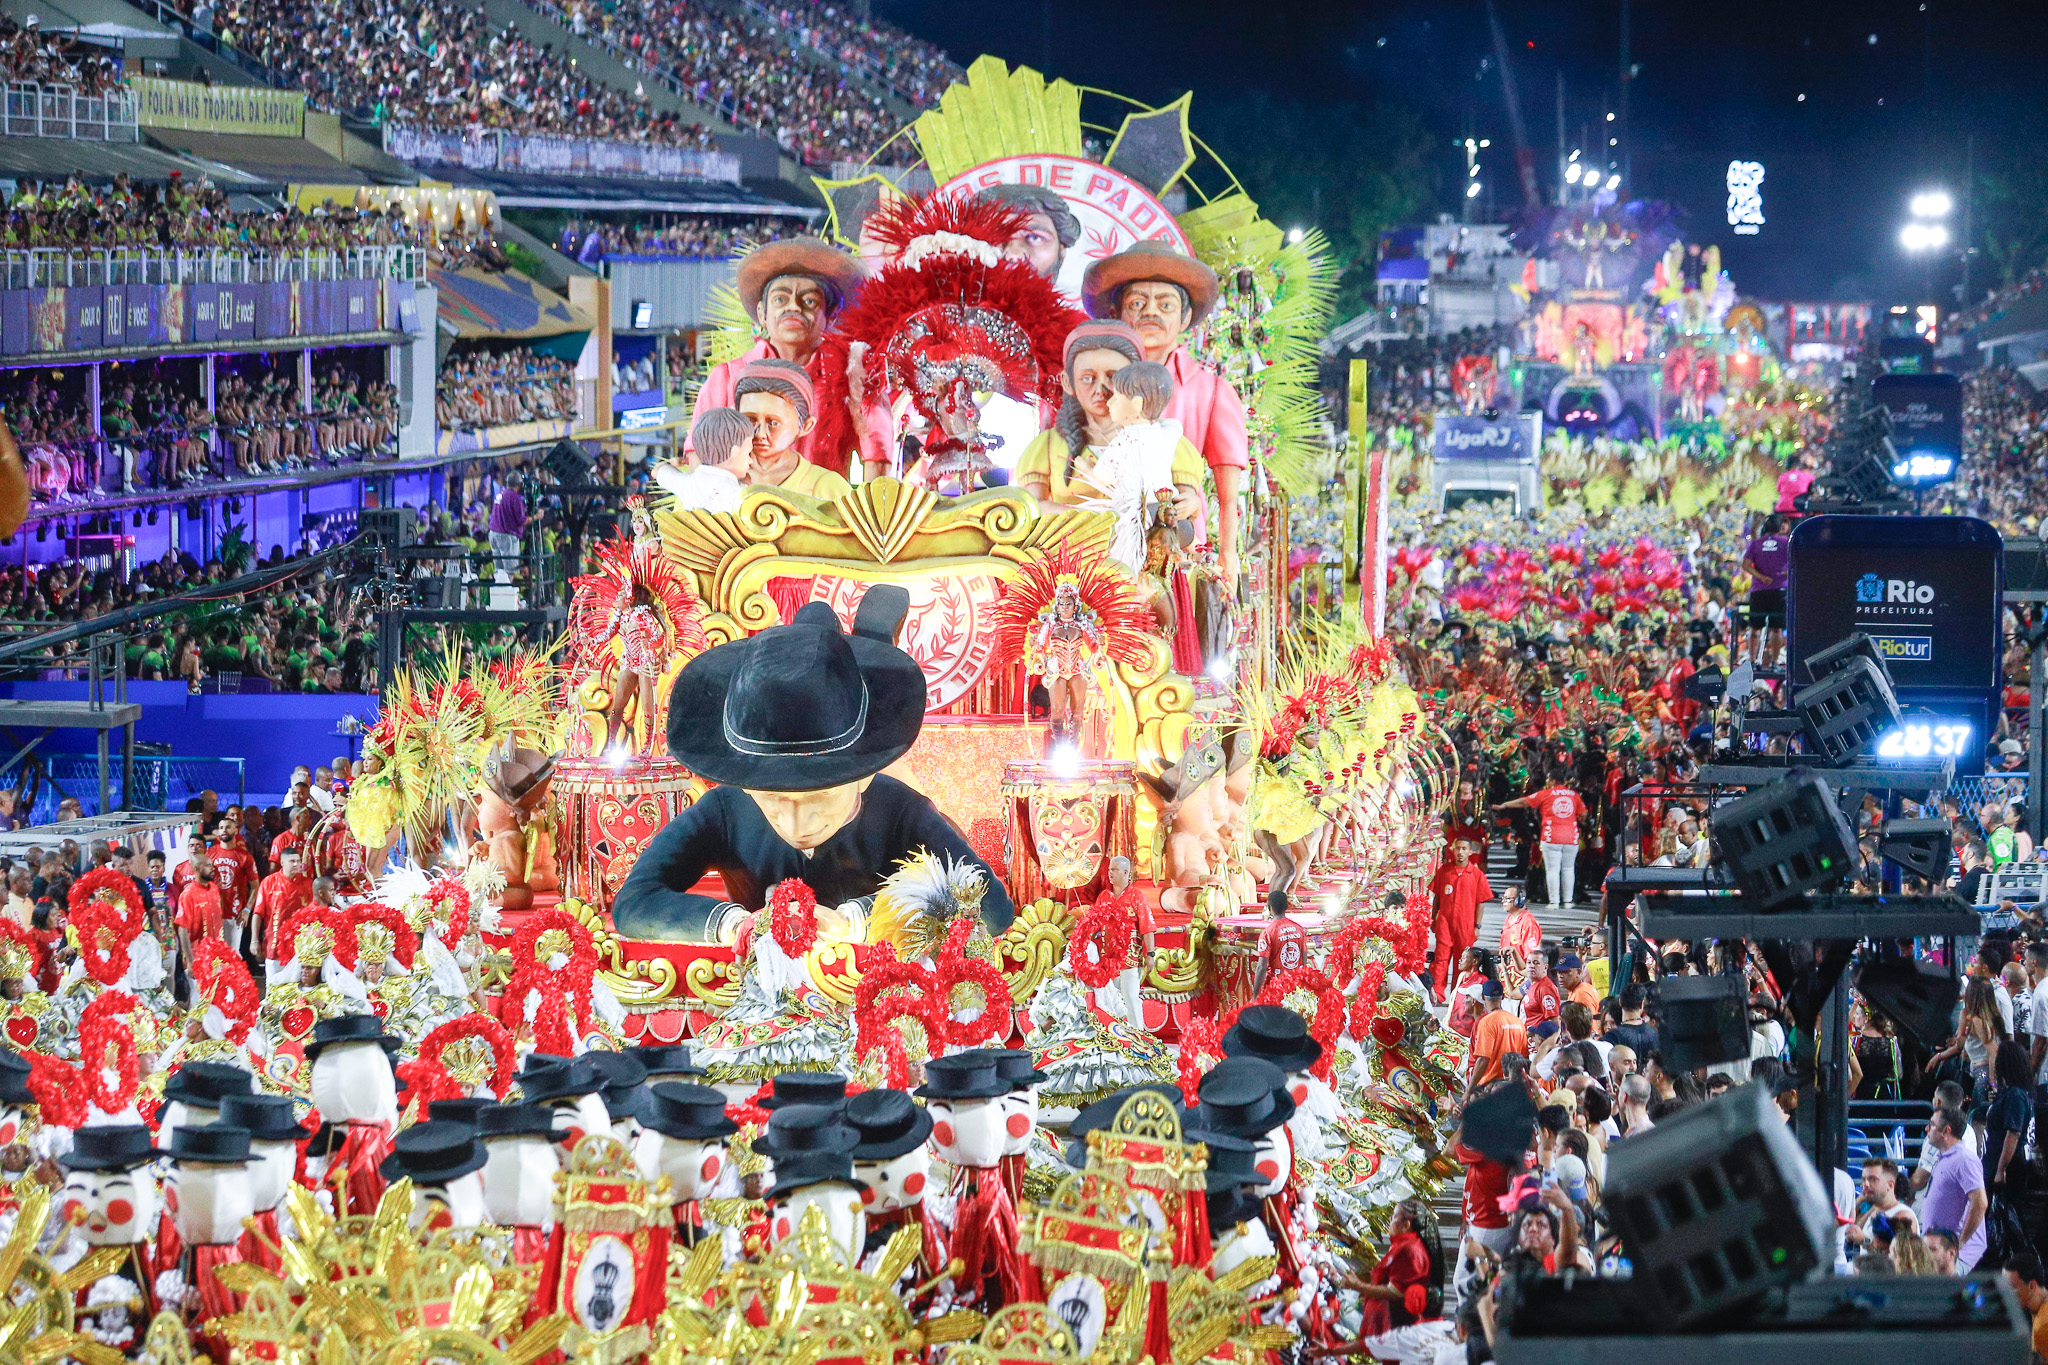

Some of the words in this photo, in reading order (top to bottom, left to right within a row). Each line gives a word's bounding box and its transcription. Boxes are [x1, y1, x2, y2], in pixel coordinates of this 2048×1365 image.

[147, 89, 174, 117] FOLIA
[178, 94, 199, 120] MAIS
[204, 97, 246, 123] TROPICAL
[249, 101, 260, 124] DA
[1019, 164, 1074, 189] DE
[1086, 174, 1177, 247] PADR
[80, 306, 96, 327] AQUI
[96, 305, 101, 326] O
[108, 294, 122, 335] REI
[219, 291, 233, 330] REI
[1887, 579, 1935, 604] Rio
[1856, 606, 1934, 615] PREFEITURA
[1878, 639, 1929, 656] Riotur
[213, 857, 238, 868] APOIO
